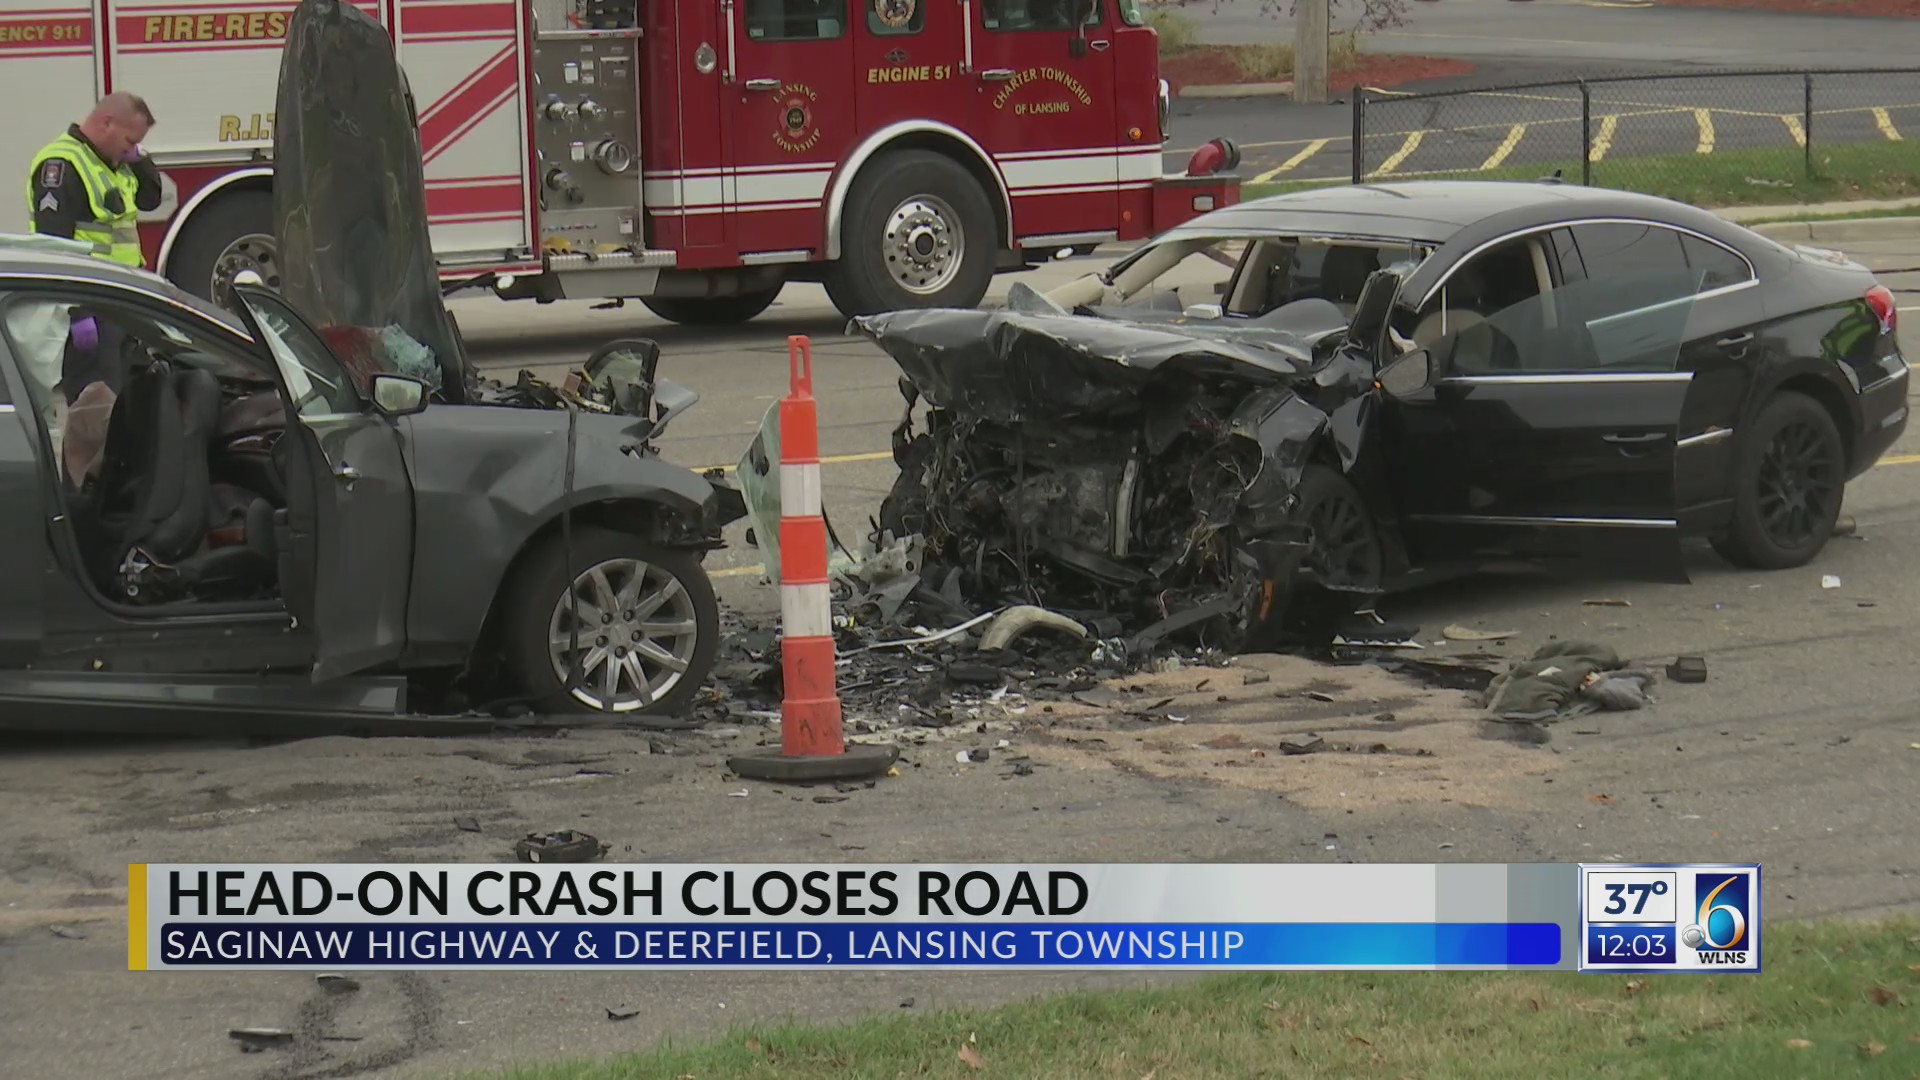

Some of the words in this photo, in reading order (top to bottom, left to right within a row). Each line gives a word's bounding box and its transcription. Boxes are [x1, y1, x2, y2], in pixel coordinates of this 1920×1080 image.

[52, 25, 81, 41] 911
[867, 65, 930, 83] ENGINE
[934, 65, 951, 80] 51
[773, 84, 817, 104] LANSING
[992, 68, 1038, 110] CHARTER
[1040, 67, 1092, 105] TOWNSHIP
[1014, 104, 1027, 115] OF
[1029, 102, 1070, 114] LANSING
[772, 127, 820, 152] TOWNSHIP
